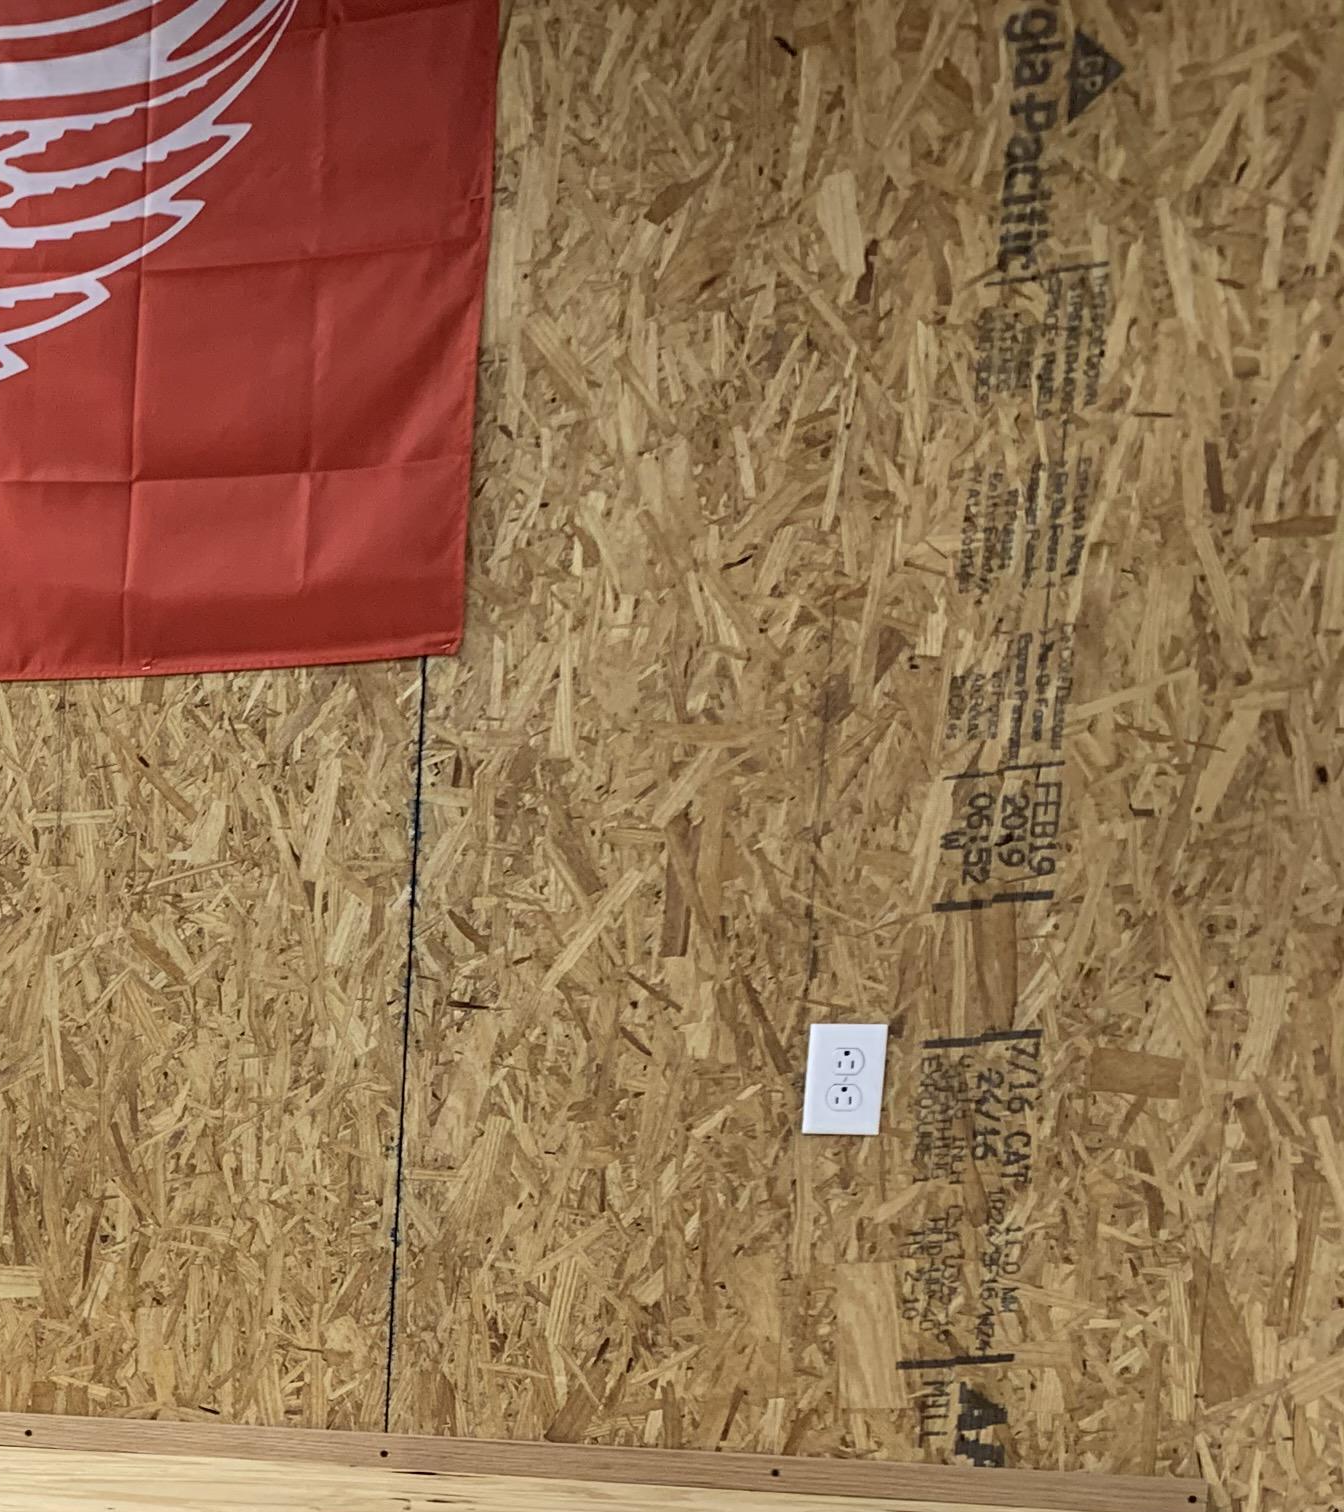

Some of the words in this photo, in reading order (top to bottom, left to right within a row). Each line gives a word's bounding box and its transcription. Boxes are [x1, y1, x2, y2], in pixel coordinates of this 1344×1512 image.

[962, 792, 996, 886] 06:52
[998, 793, 1030, 868] 2019
[1029, 781, 1063, 876] FEB19
[972, 1068, 1005, 1161] 24/16
[1006, 1040, 1041, 1114] 7/16
[1001, 1131, 1033, 1185] CAT
[918, 1380, 953, 1449] MILL
